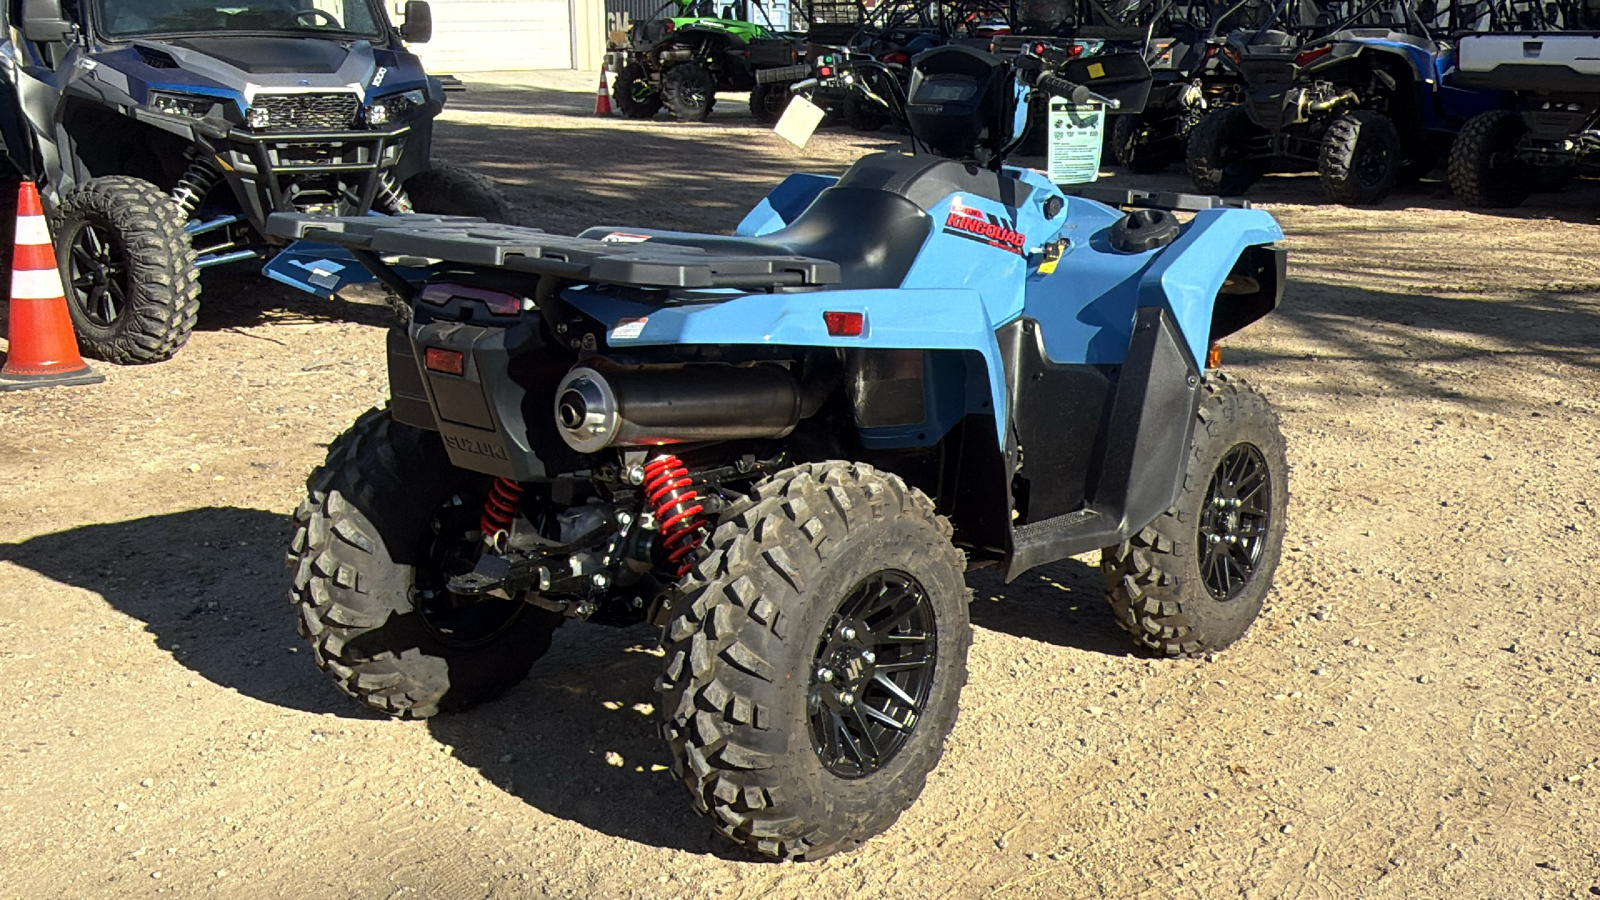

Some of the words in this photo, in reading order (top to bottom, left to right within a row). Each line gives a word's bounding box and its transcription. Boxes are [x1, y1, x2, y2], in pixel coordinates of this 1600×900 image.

[371, 66, 388, 88] 1000
[945, 212, 1026, 247] KINGQUAD
[444, 434, 511, 461] SUZUKI
